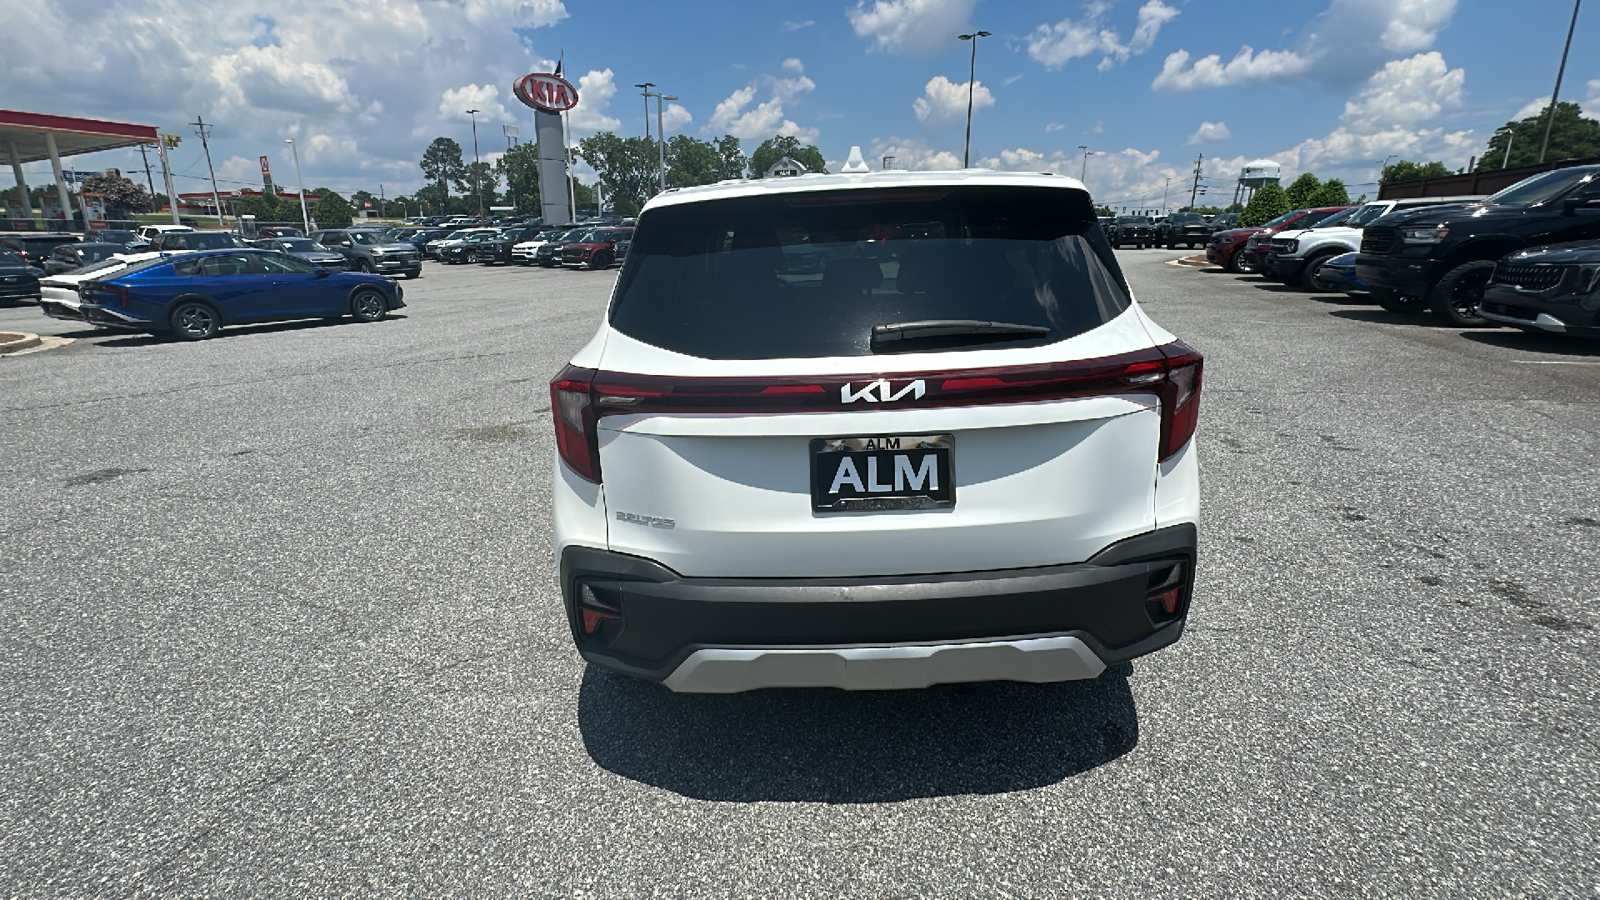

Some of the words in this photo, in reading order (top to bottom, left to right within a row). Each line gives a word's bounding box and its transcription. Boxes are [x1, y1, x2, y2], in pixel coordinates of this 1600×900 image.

[530, 78, 571, 106] KIA
[841, 379, 925, 404] KIA
[865, 437, 900, 450] ALM
[828, 453, 939, 494] ALM
